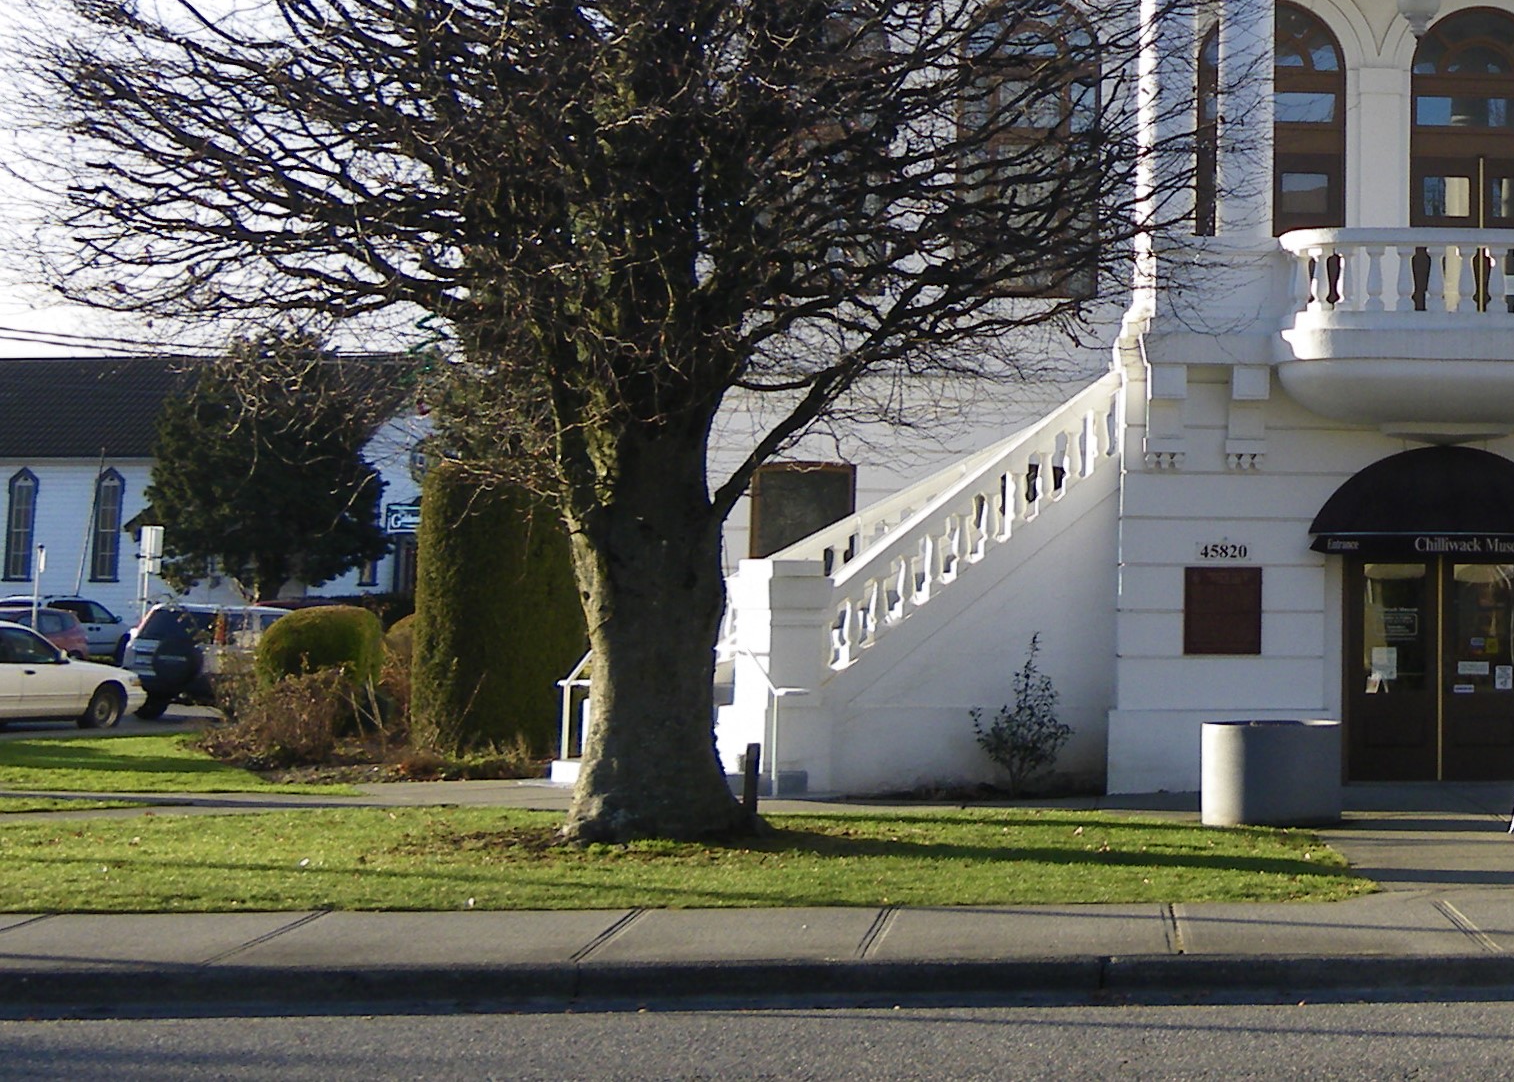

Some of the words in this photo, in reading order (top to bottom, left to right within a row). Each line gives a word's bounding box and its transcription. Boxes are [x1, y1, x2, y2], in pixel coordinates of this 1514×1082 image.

[1200, 544, 1248, 559] 45820
[1326, 538, 1360, 550] Entrance
[1414, 536, 1482, 553] Chilliwack
